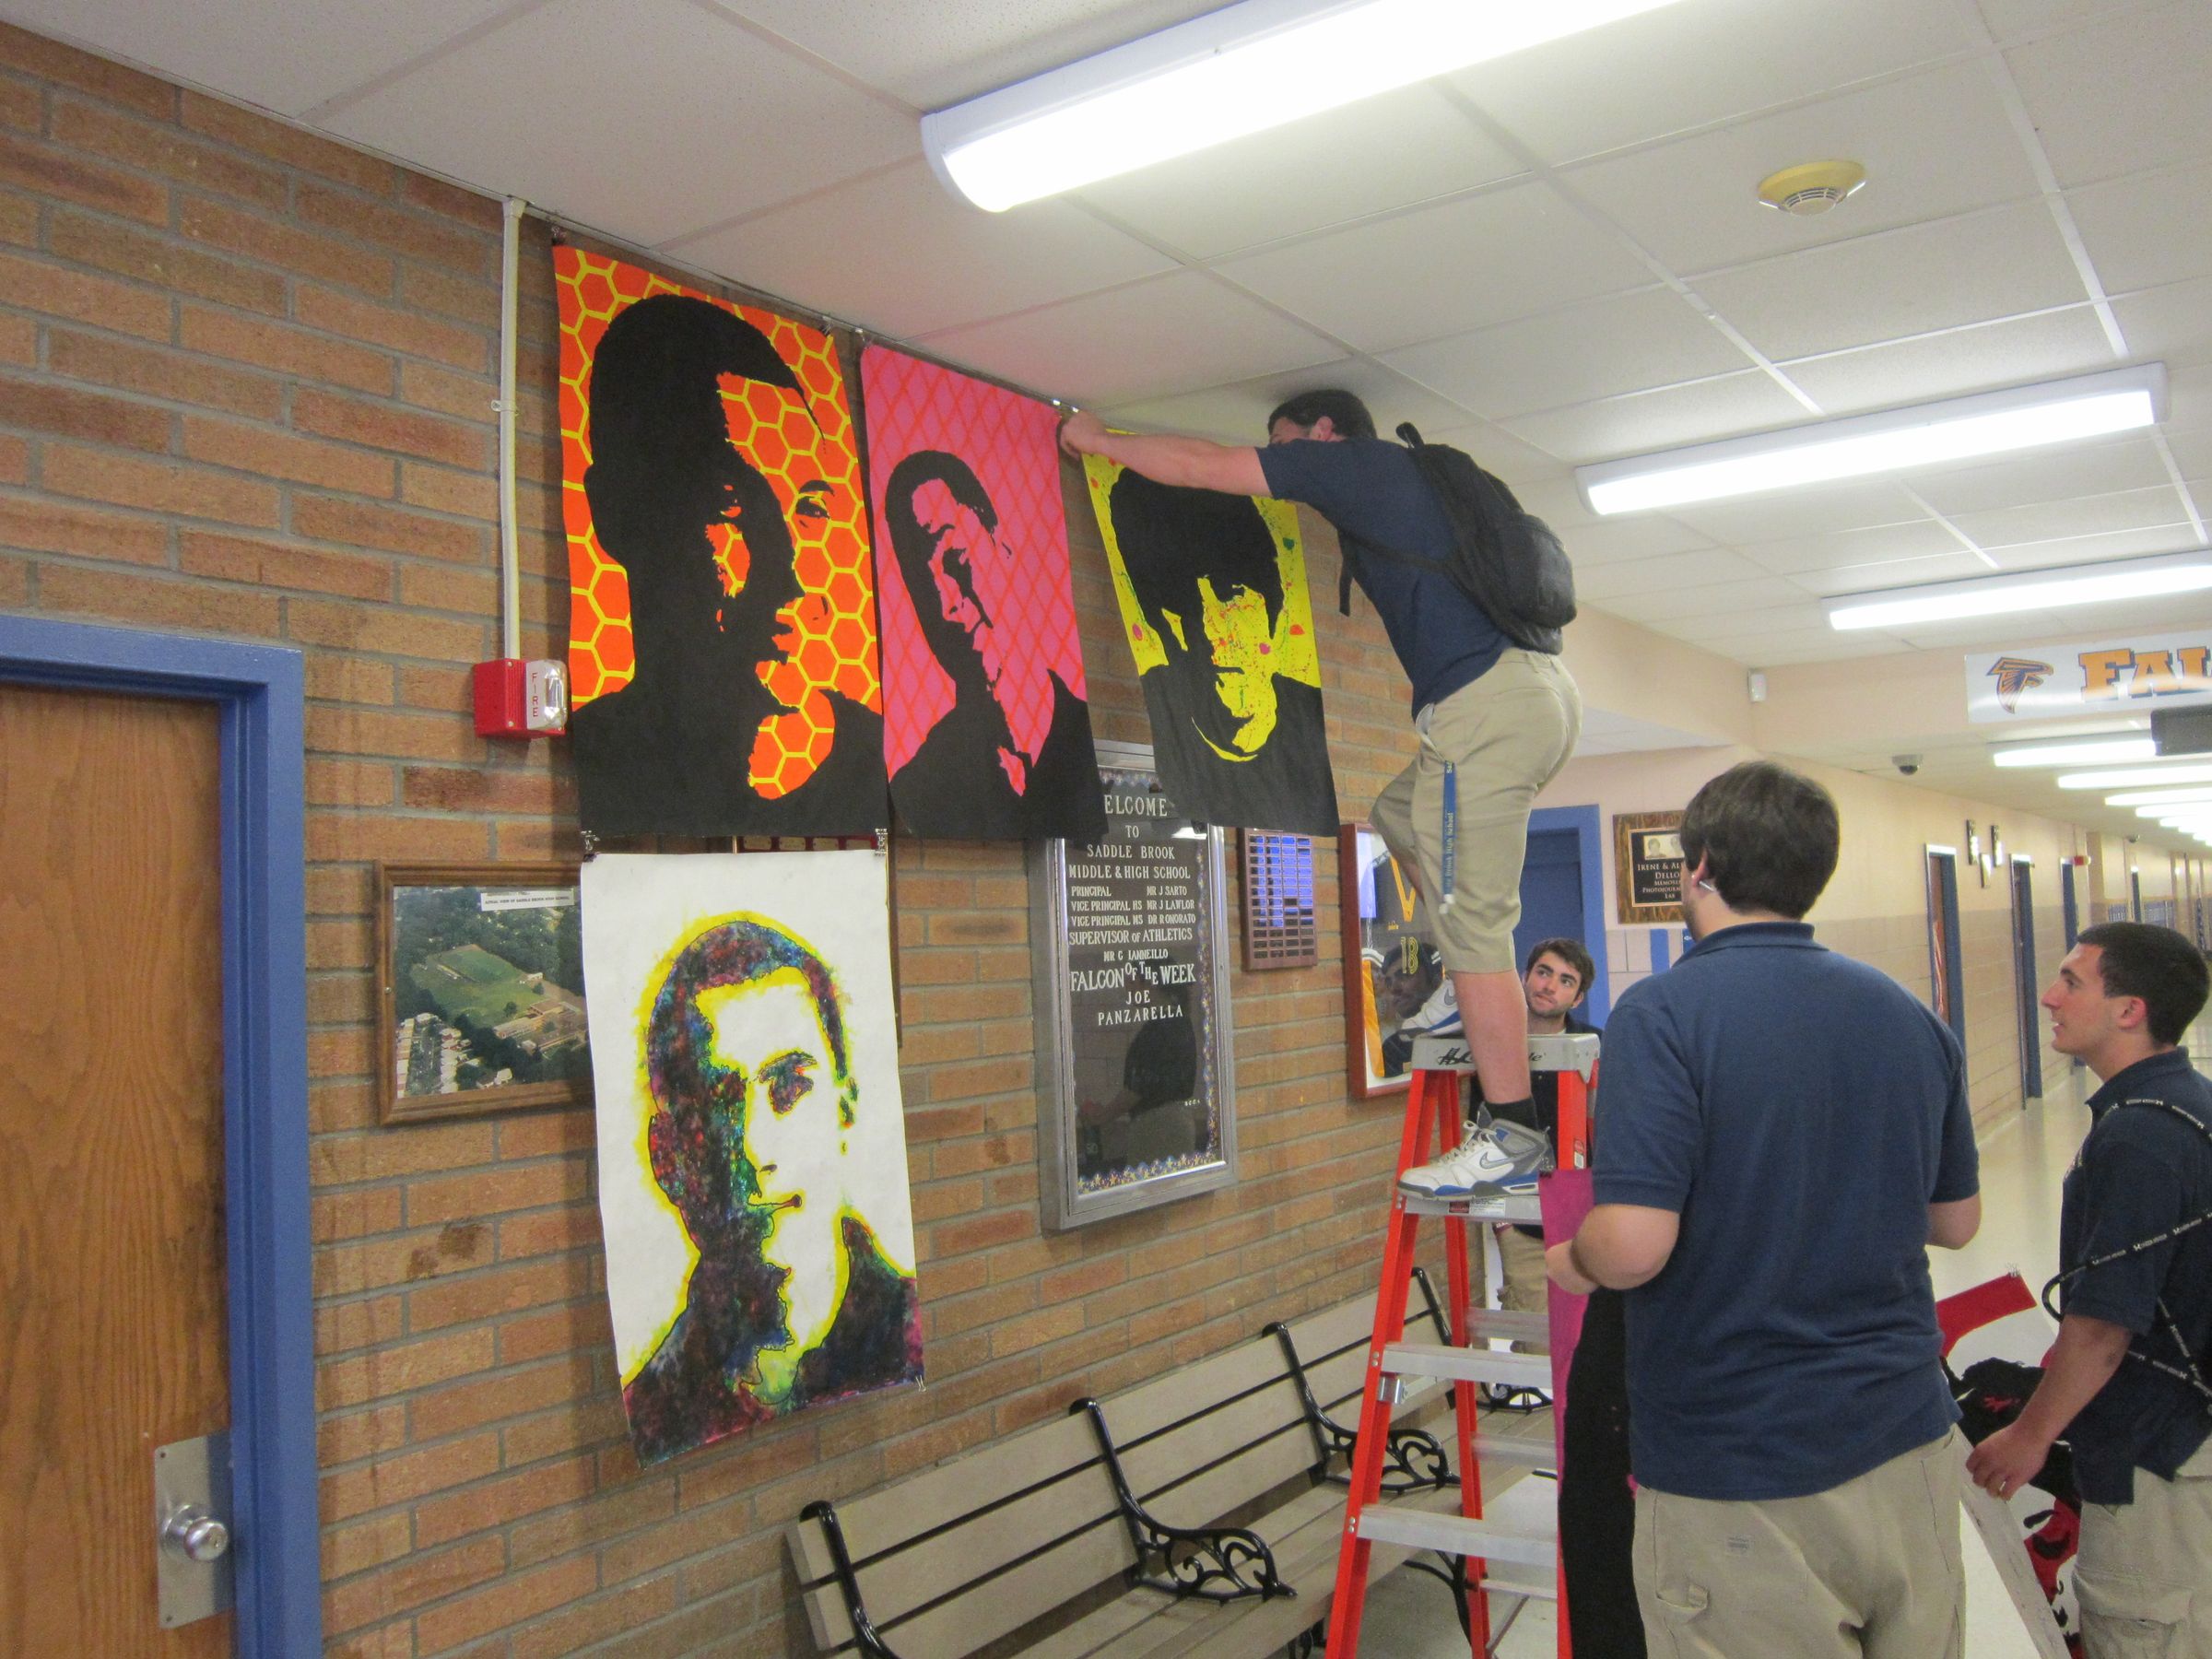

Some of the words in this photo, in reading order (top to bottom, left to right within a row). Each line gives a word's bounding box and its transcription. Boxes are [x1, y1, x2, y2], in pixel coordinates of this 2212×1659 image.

[531, 672, 539, 717] FIRE
[1104, 794, 1168, 817] ELCOME
[1125, 825, 1139, 838] TO
[1088, 844, 1133, 858] SADDLE
[1141, 846, 1175, 859] BROOK
[1069, 865, 1112, 878] MIDDLE
[1115, 865, 1122, 878] &
[1124, 865, 1149, 878] HIGH
[1154, 866, 1191, 879] SCHOOL
[1071, 886, 1112, 897] PRINCIPAL
[1147, 886, 1157, 896] MR
[1159, 886, 1163, 896] J
[1165, 886, 1187, 896] SARTO
[1071, 900, 1089, 912] VICE
[1090, 900, 1131, 912] PRINCIPAL
[1147, 900, 1157, 911] MR
[1159, 900, 1163, 910] J
[1165, 900, 1194, 911] LAWLOR
[1071, 915, 1089, 927] VICE
[1090, 914, 1131, 926] PRINCIPAL
[1147, 914, 1158, 924] DR
[1069, 929, 1130, 946] SUPERVISOR
[1143, 927, 1193, 942] ATHLETICS
[1103, 951, 1115, 962] MR
[1070, 968, 1124, 992] FALCON
[1125, 962, 1137, 981] OF
[1139, 961, 1159, 985] THE
[1159, 963, 1197, 985] WEEK
[1126, 990, 1150, 1006] JOE
[1099, 1004, 1183, 1026] PANZARELLA
